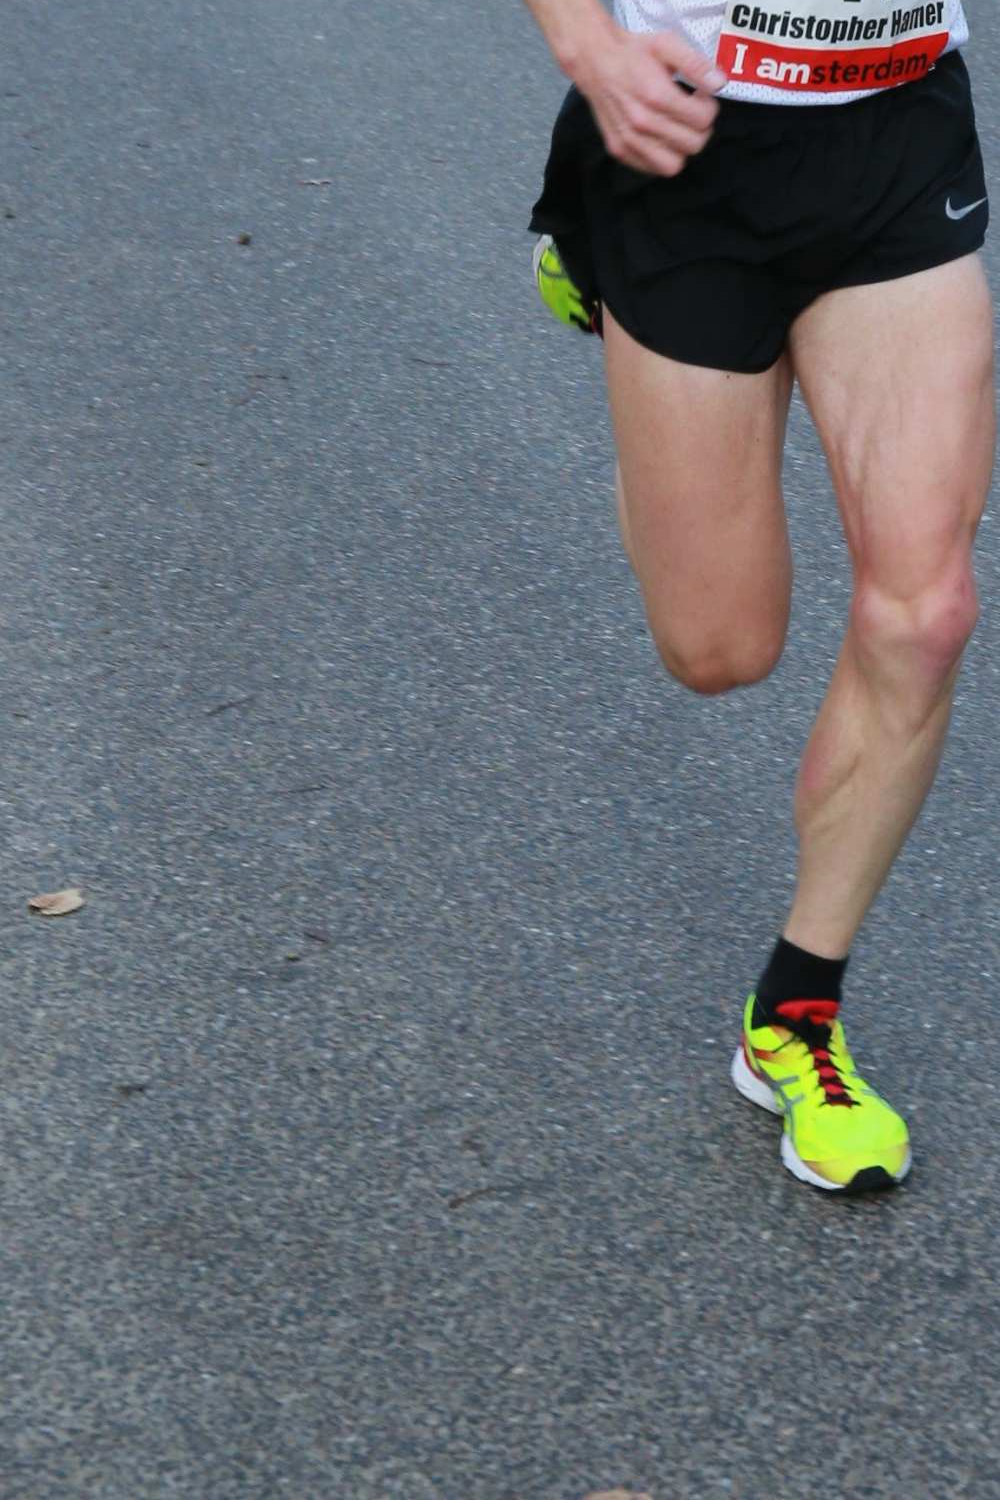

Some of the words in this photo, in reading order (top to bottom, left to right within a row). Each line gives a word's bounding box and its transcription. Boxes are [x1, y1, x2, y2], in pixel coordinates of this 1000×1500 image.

[731, 4, 888, 44] Christopher
[731, 43, 749, 75] I
[756, 52, 928, 85] amsterdam
